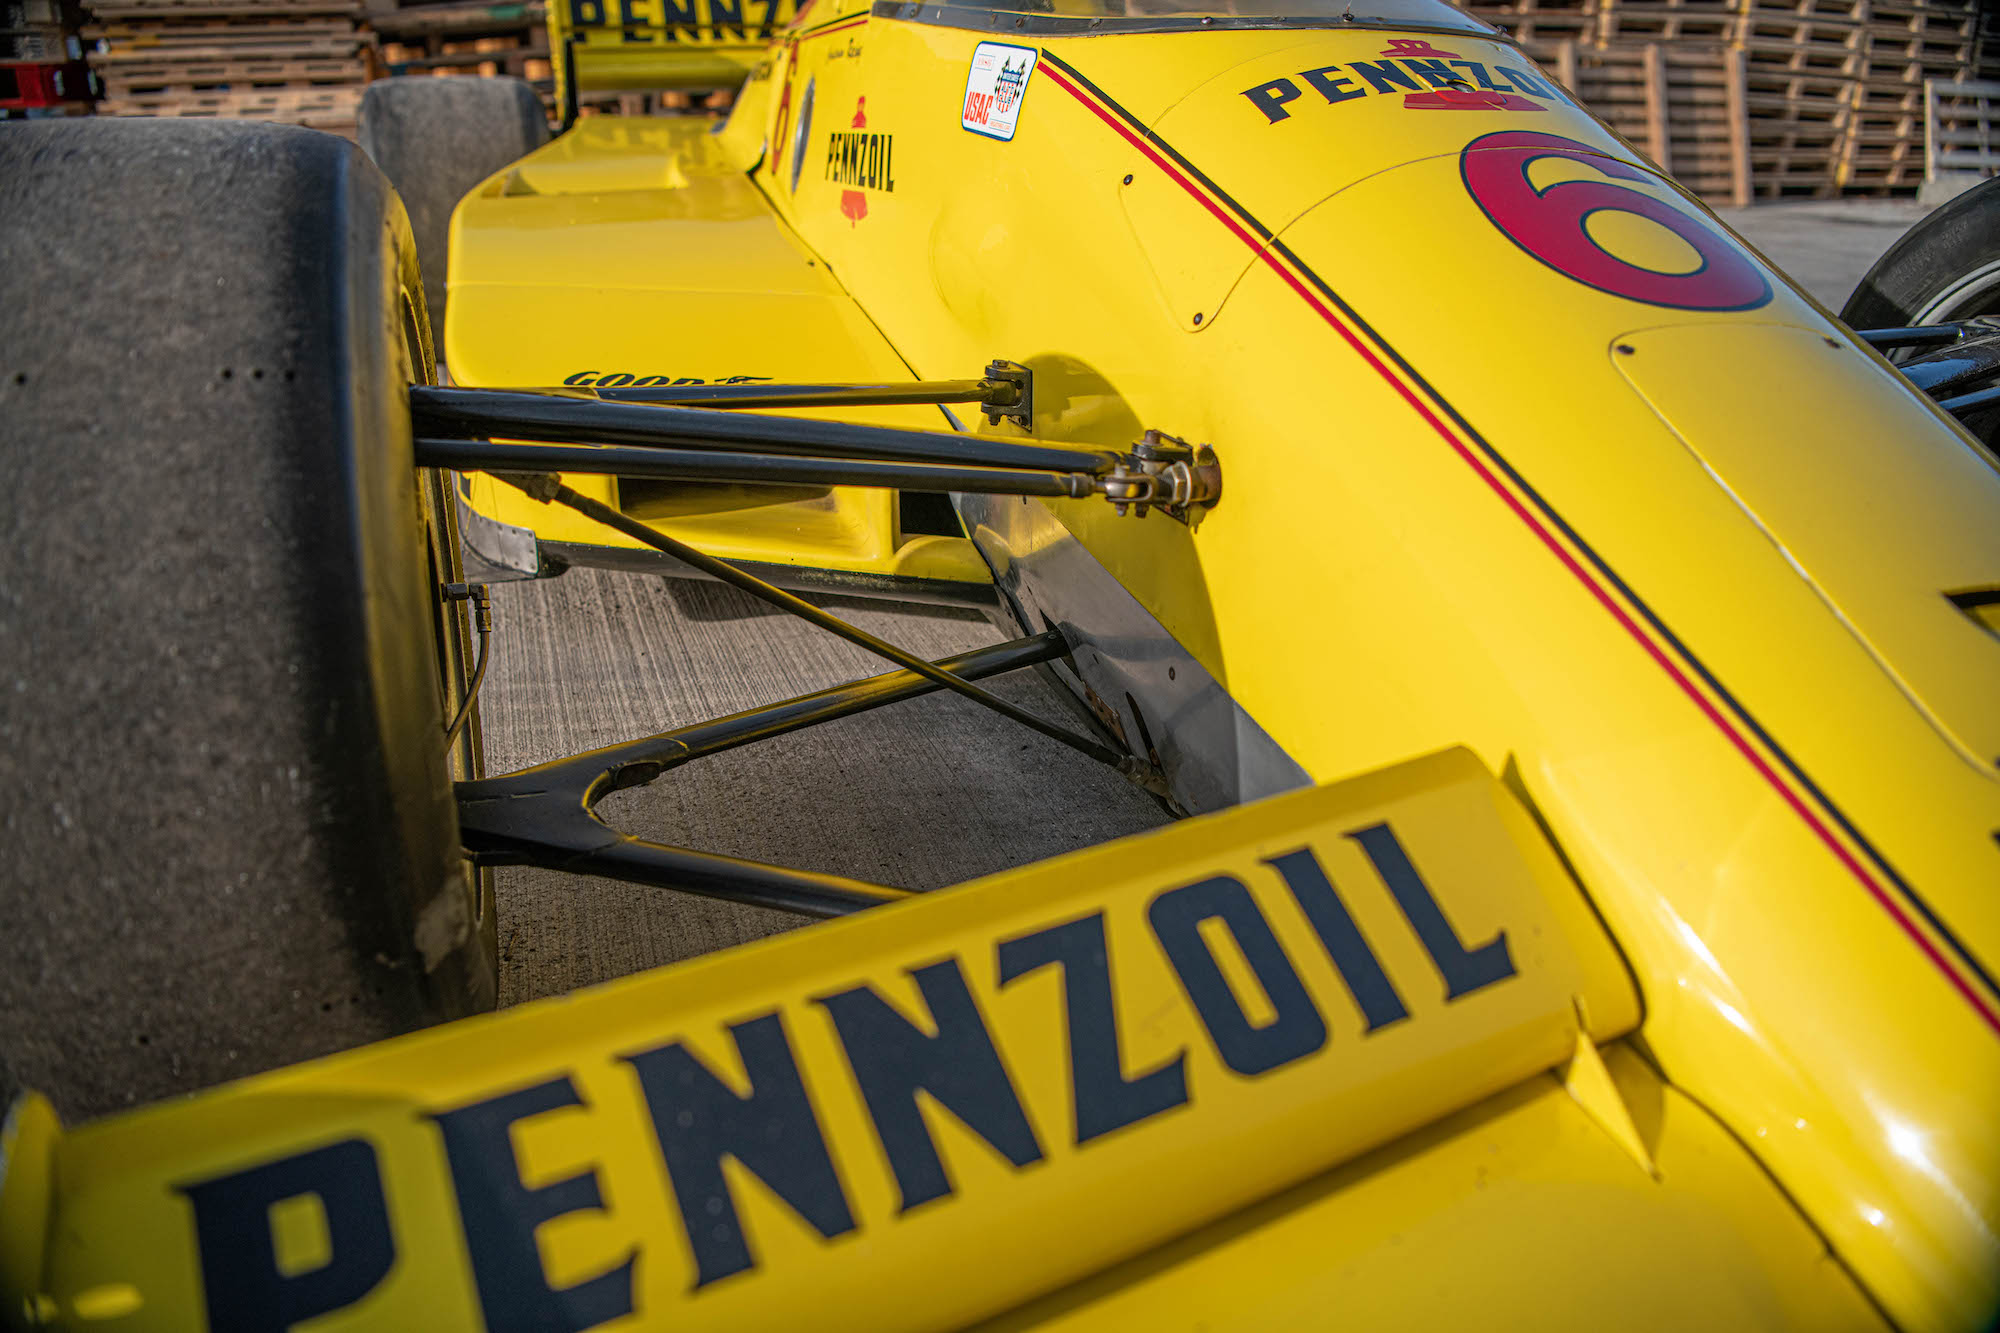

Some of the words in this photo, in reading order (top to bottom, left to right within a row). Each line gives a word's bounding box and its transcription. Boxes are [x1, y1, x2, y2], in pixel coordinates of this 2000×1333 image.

[570, 0, 803, 42] PENNZ
[964, 91, 994, 125] USAC
[1239, 58, 1582, 125] PENNZOI
[825, 133, 895, 193] PENNZOIL
[1460, 130, 1773, 311] 6
[172, 821, 1519, 1333] PENNZOIL
